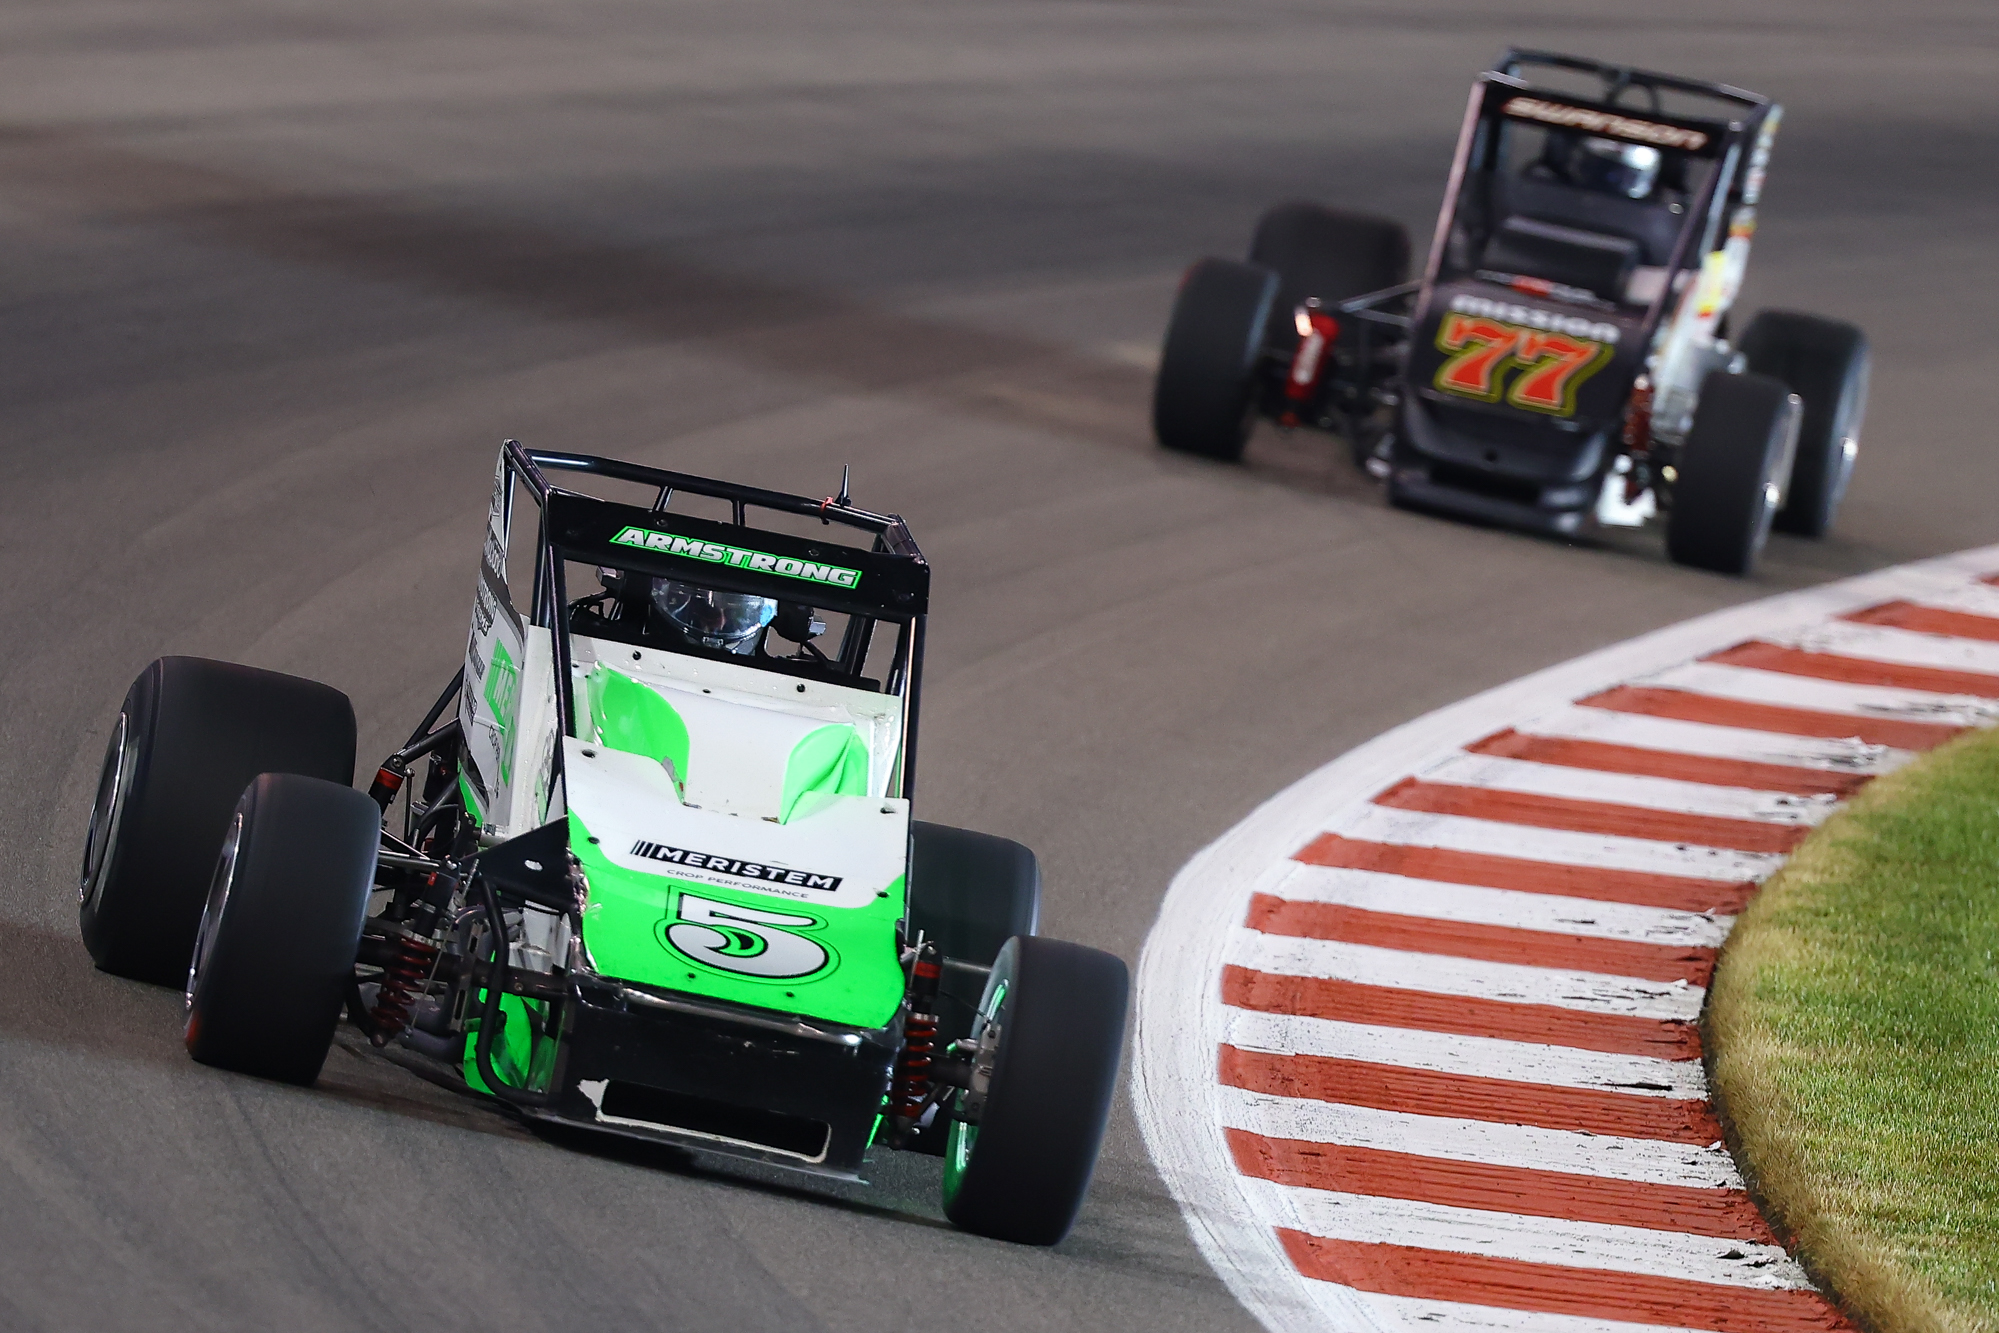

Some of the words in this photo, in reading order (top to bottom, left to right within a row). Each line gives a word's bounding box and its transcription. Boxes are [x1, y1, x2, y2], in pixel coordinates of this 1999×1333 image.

[1437, 312, 1614, 416] 77
[618, 528, 857, 586] ARMSTRONG
[655, 846, 835, 889] MERISTEM
[666, 868, 704, 880] CROP
[707, 875, 809, 899] PERFORMANCE
[664, 892, 830, 980] 5
